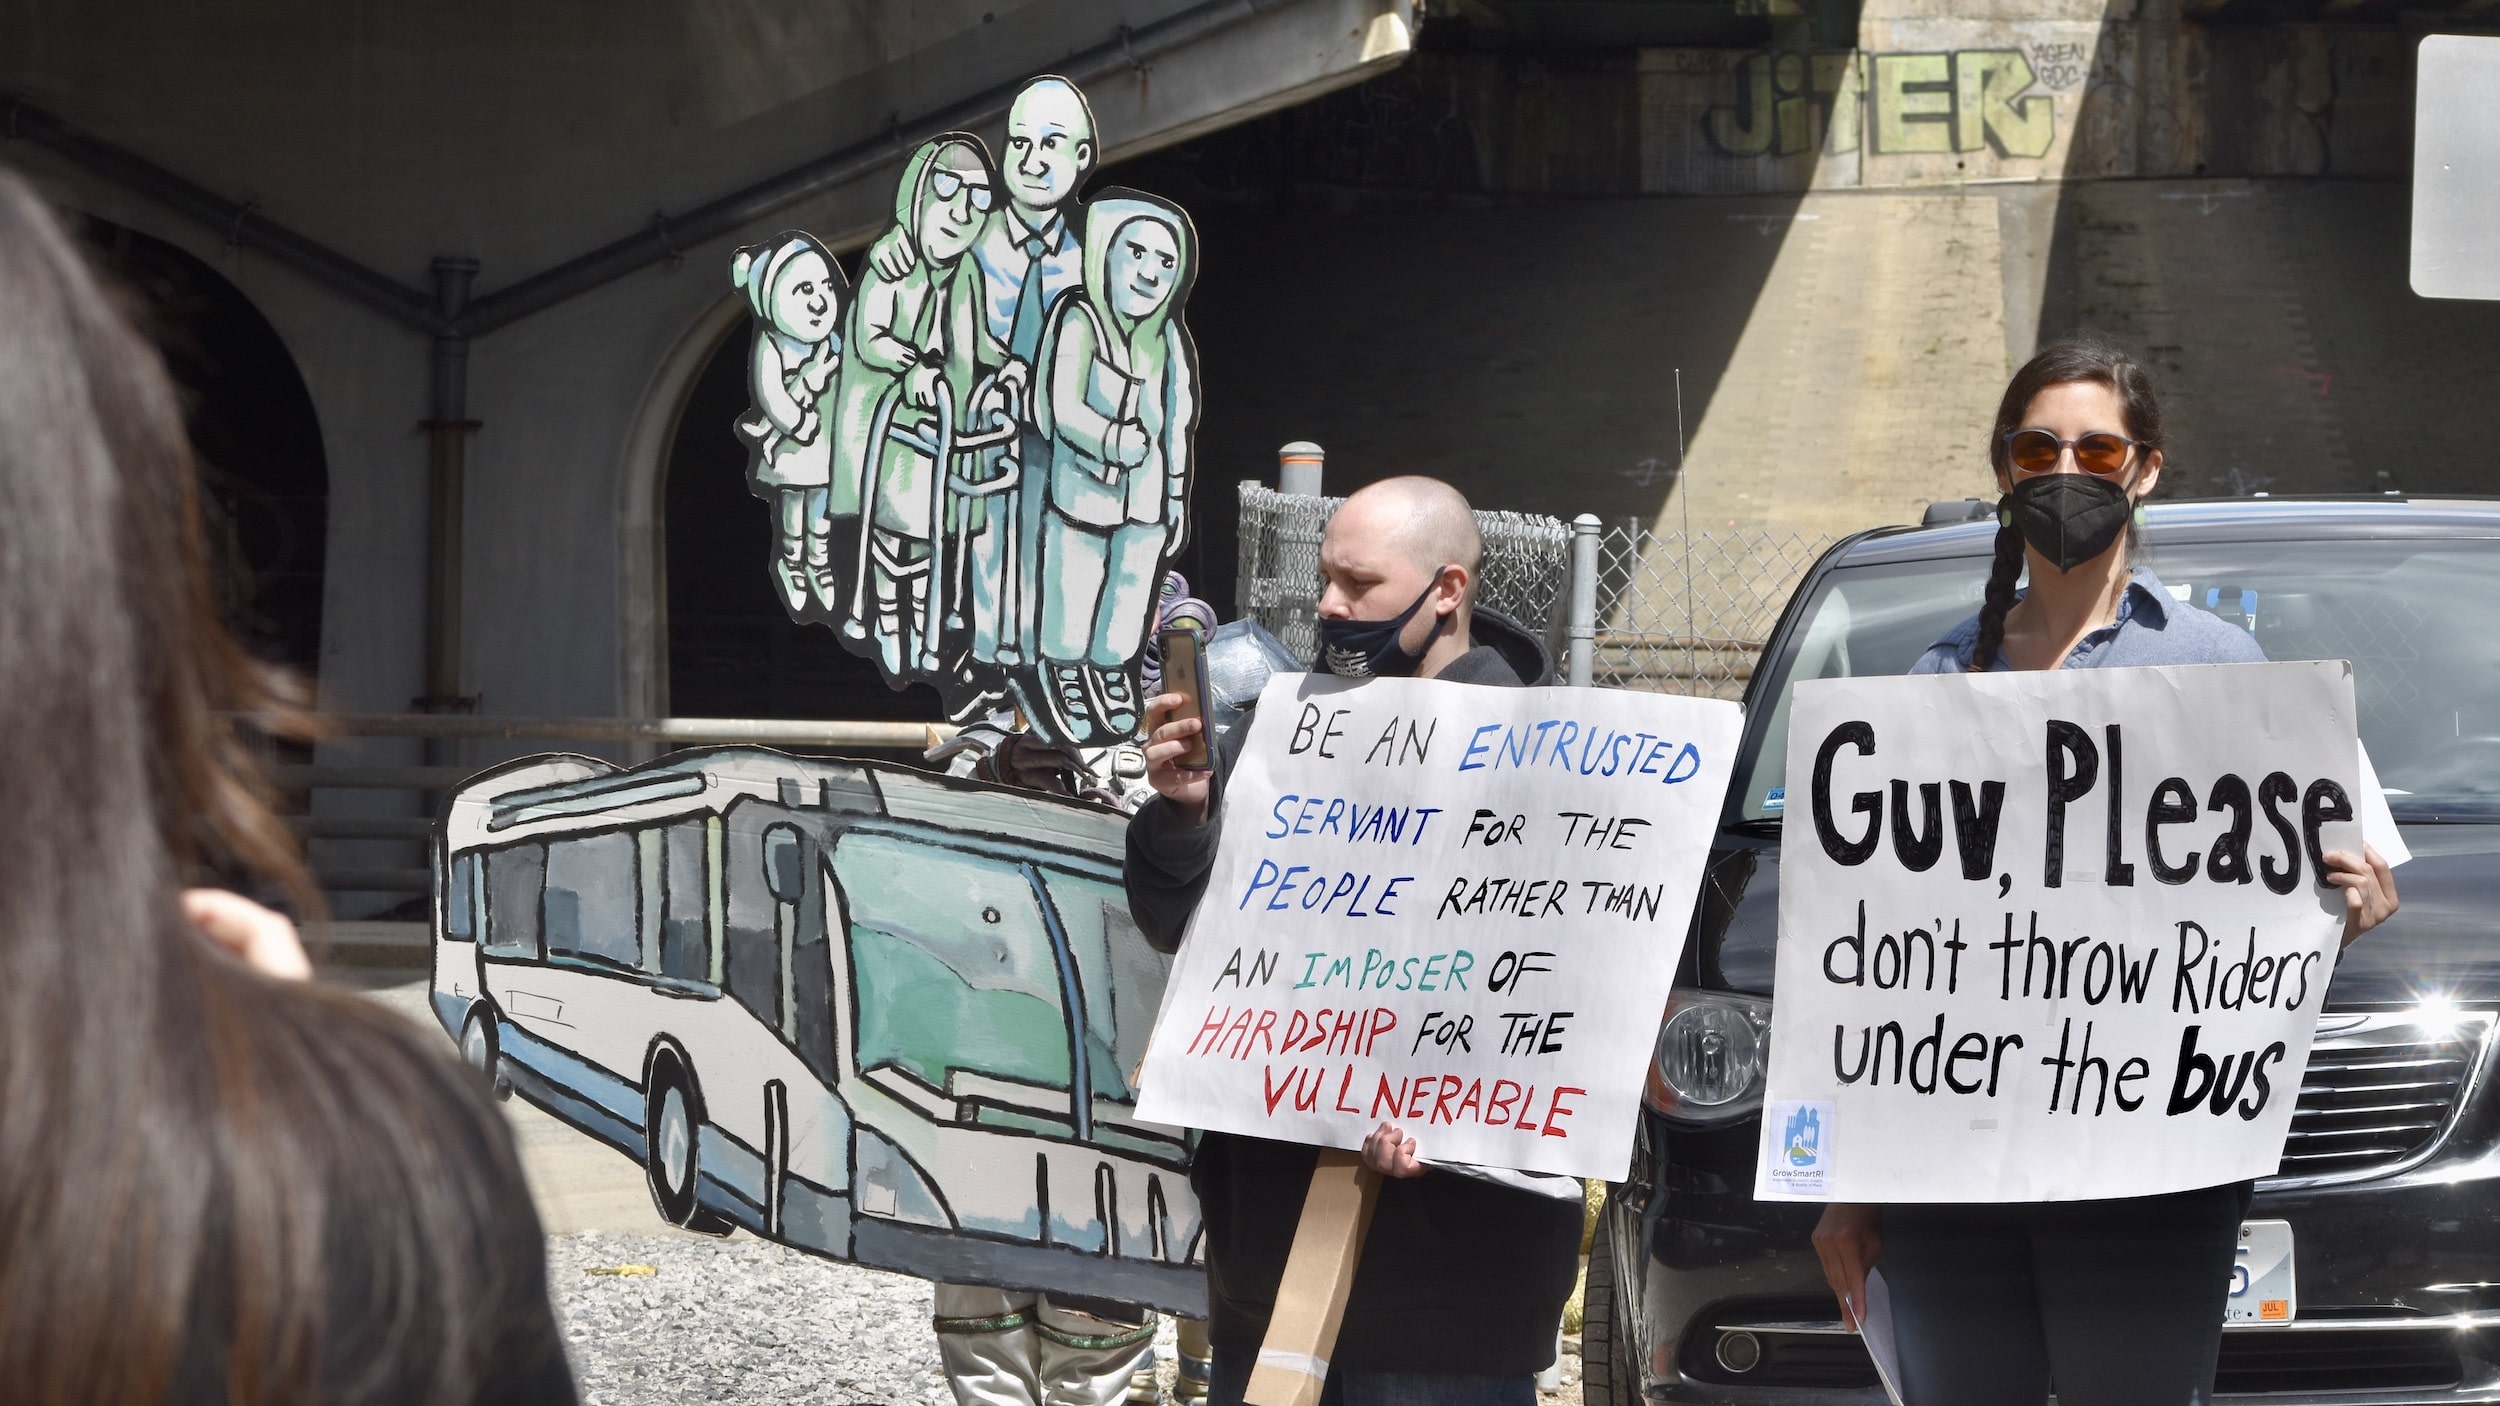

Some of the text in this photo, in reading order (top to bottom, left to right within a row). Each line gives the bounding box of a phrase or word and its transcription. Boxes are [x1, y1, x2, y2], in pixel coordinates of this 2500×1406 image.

[1289, 703, 1700, 784] BE AN ENTRUSTED
[1266, 795, 1652, 851] SERVANT FOR THE
[1812, 719, 2353, 898] Guv, Please
[1240, 859, 1663, 922] PEOPLE RATHER THAN
[1212, 948, 1556, 995] AN IMPOSER OF
[1823, 900, 2321, 1014] don't throw Riders
[1188, 1006, 1574, 1060] HARDSHIP FOR THE
[1834, 1013, 2286, 1121] under the bus
[1264, 1065, 1587, 1138] VULNERABLE
[2263, 1302, 2279, 1312] JUL
